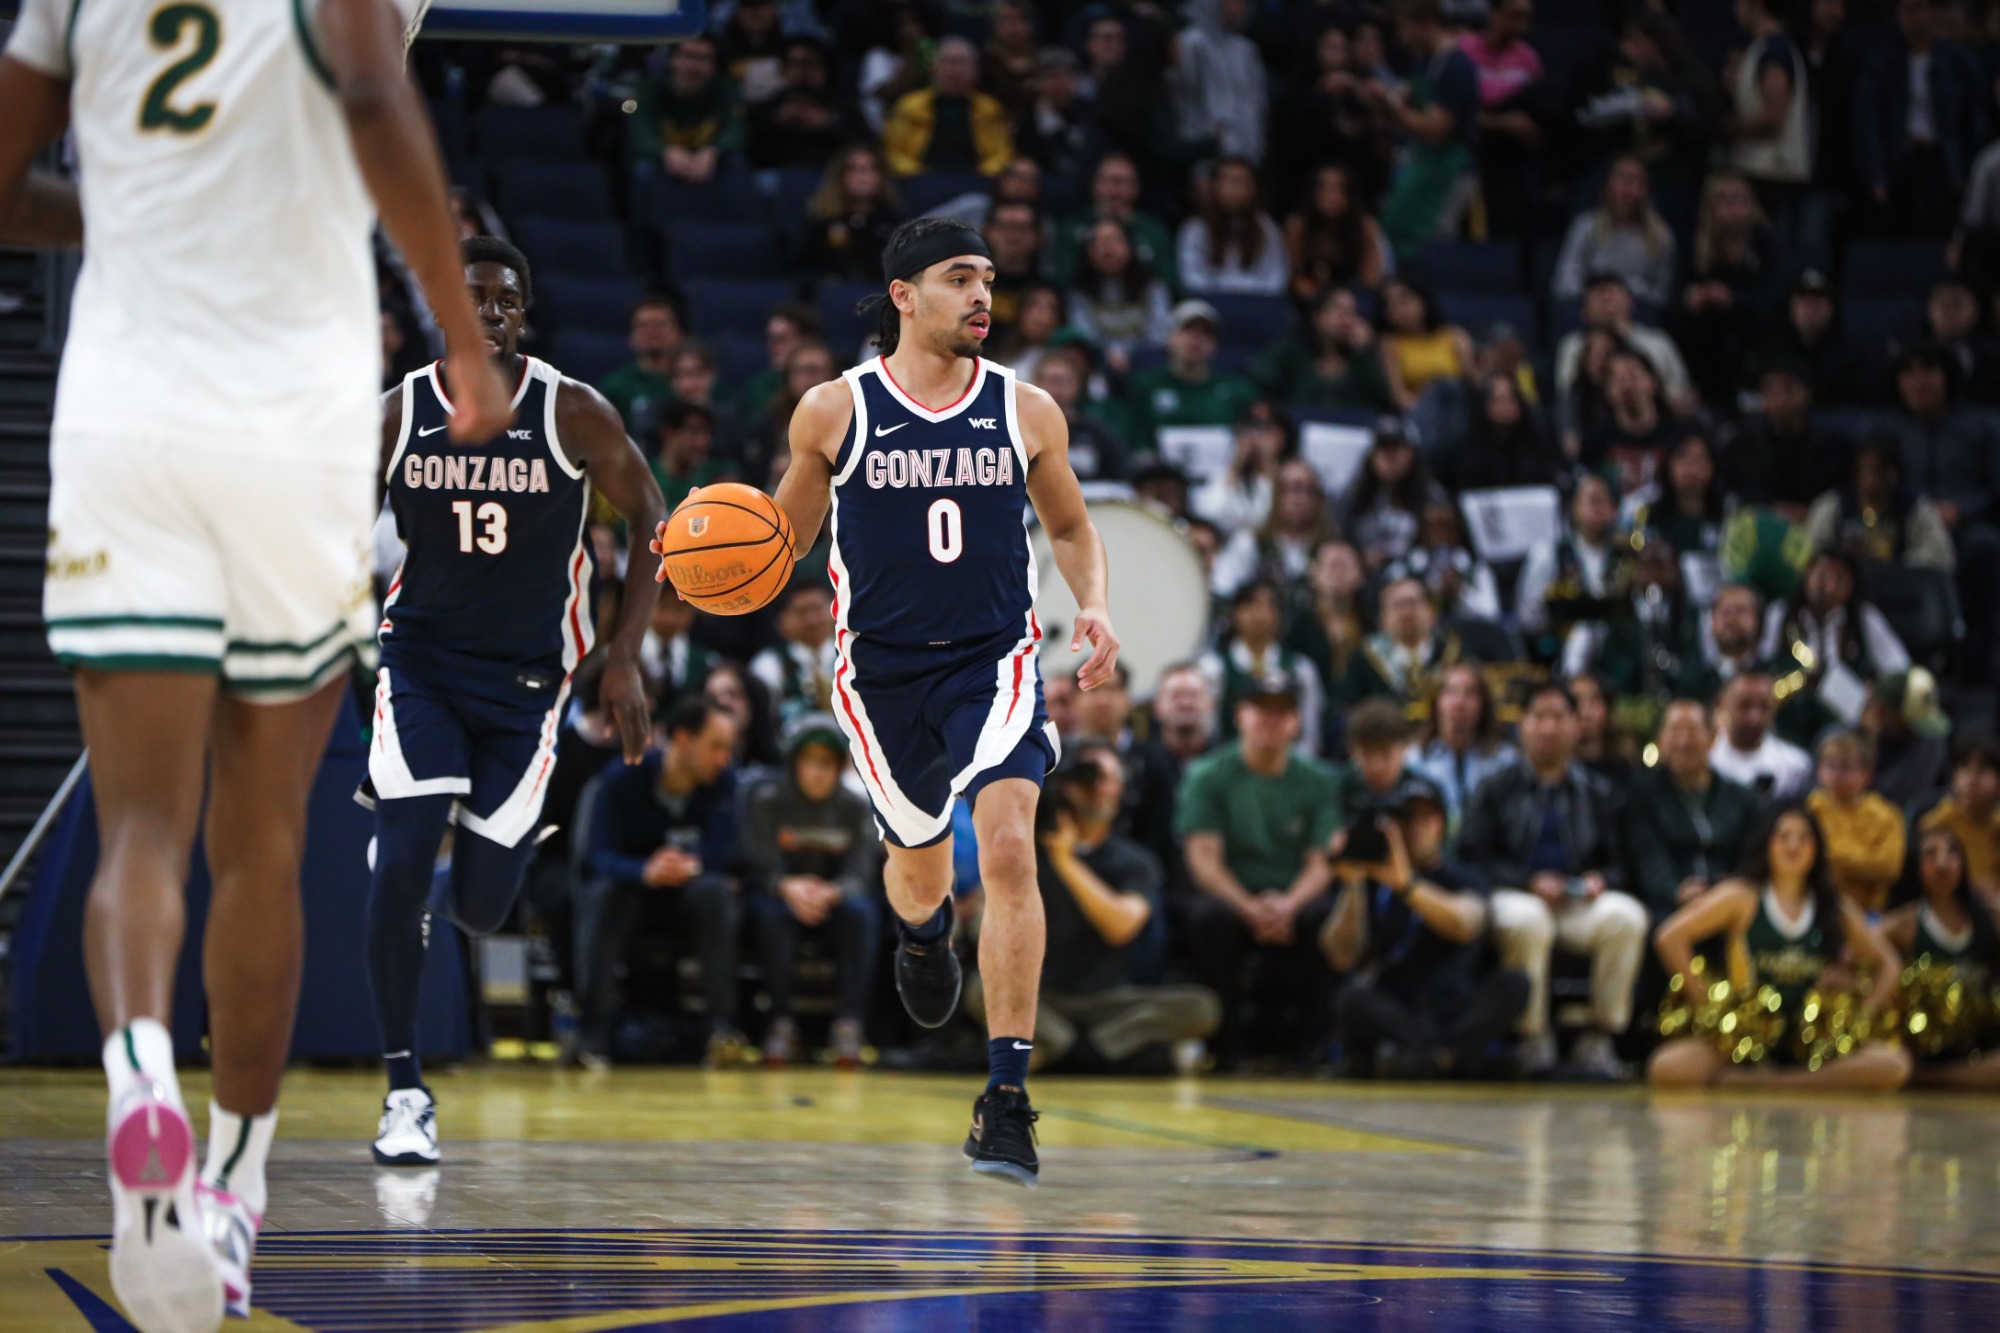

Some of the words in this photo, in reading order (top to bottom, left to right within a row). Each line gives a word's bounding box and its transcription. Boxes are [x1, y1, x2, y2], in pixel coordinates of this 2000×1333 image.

[138, 2, 222, 134] 2
[404, 454, 550, 493] GONZAGA
[865, 447, 1014, 489] GONZAGA
[452, 500, 507, 555] 13
[927, 498, 963, 563] 0
